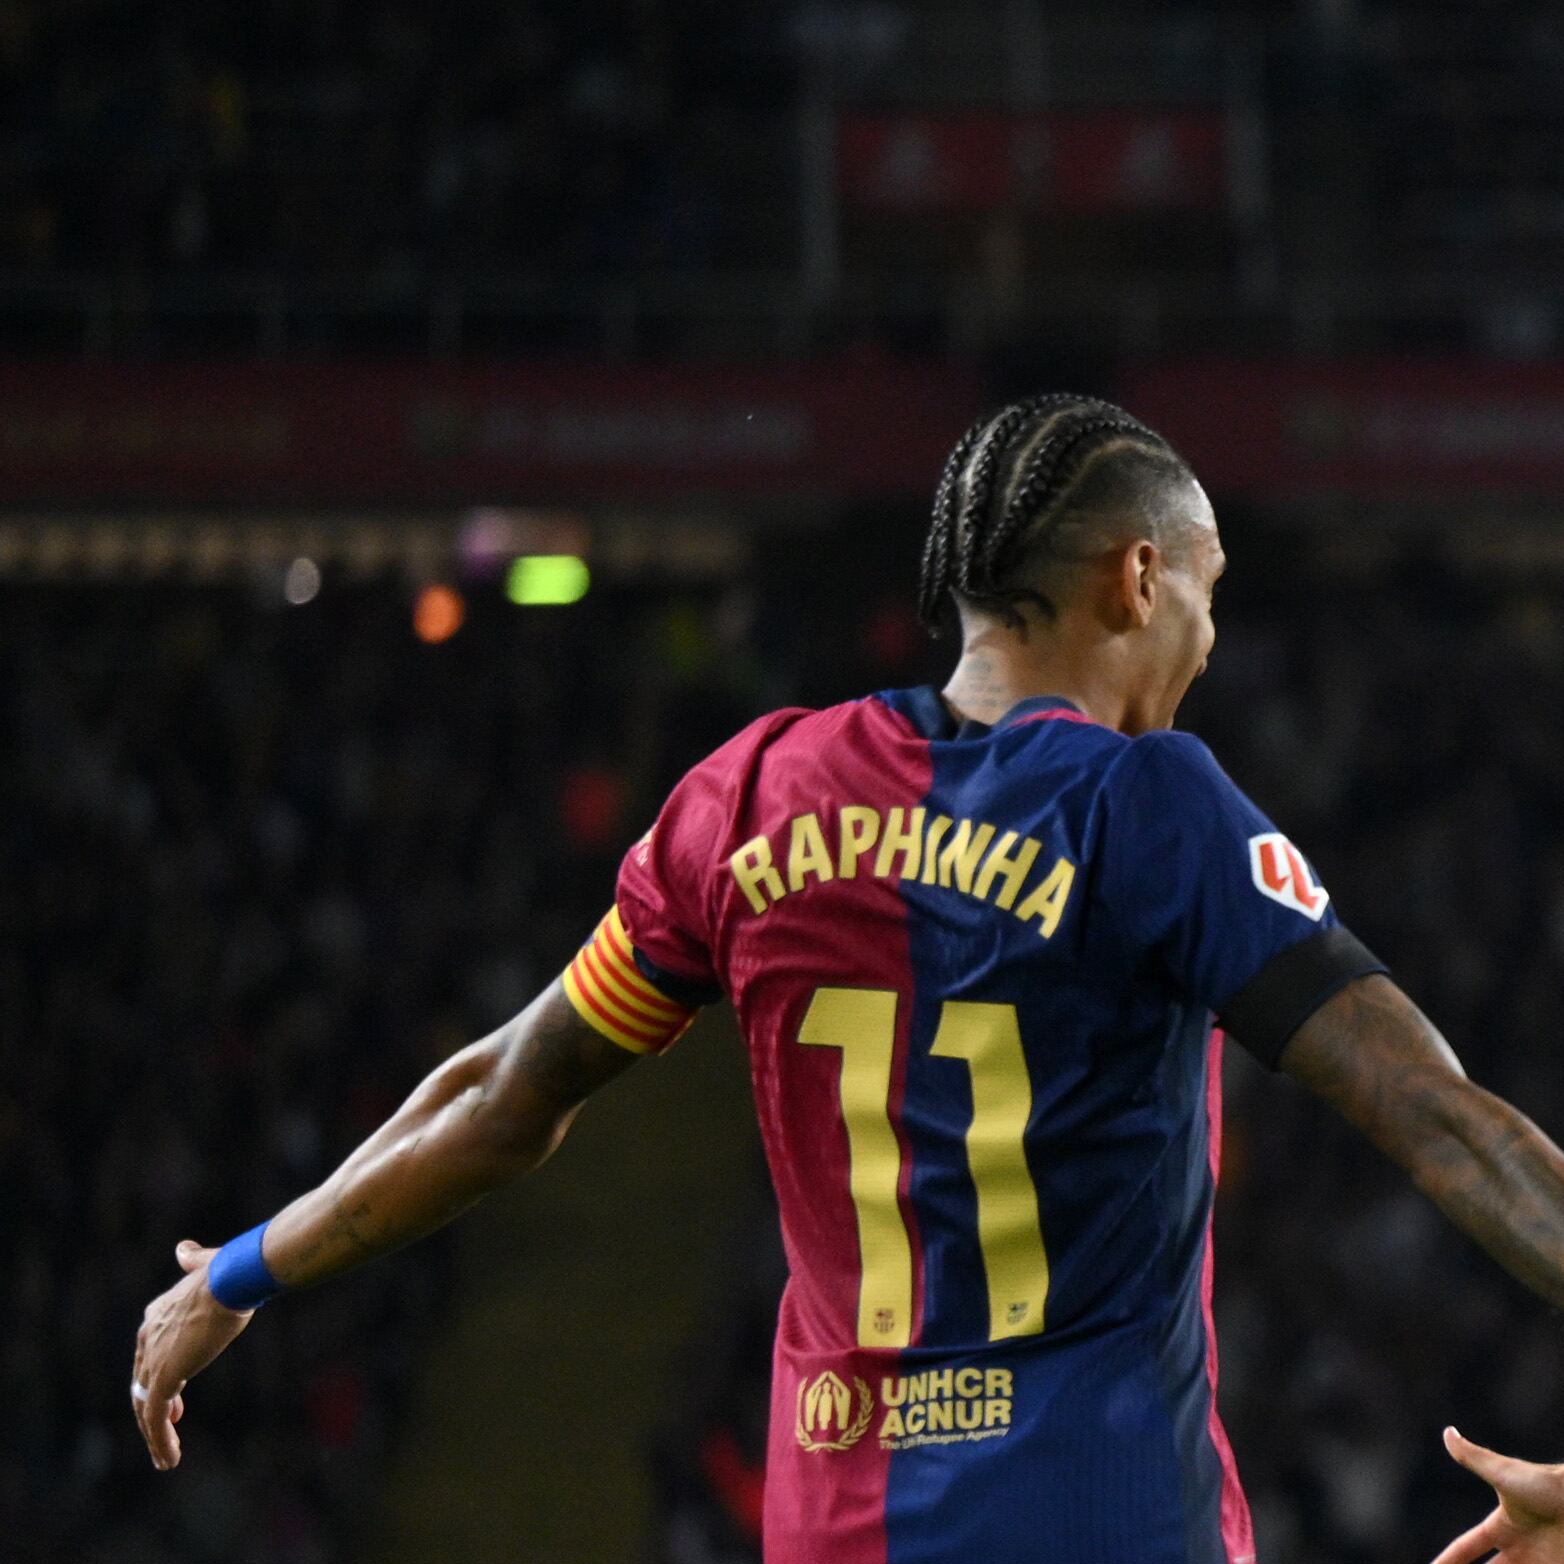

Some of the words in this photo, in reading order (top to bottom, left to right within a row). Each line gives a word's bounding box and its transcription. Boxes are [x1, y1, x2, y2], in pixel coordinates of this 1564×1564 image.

[730, 805, 1076, 940] RAPHINHA
[797, 987, 1049, 1348] 11
[881, 1367, 1014, 1408] UNHCR
[878, 1400, 1012, 1438] ACNUR
[917, 1433, 965, 1446] Refugee
[966, 1427, 1010, 1441] Agency
